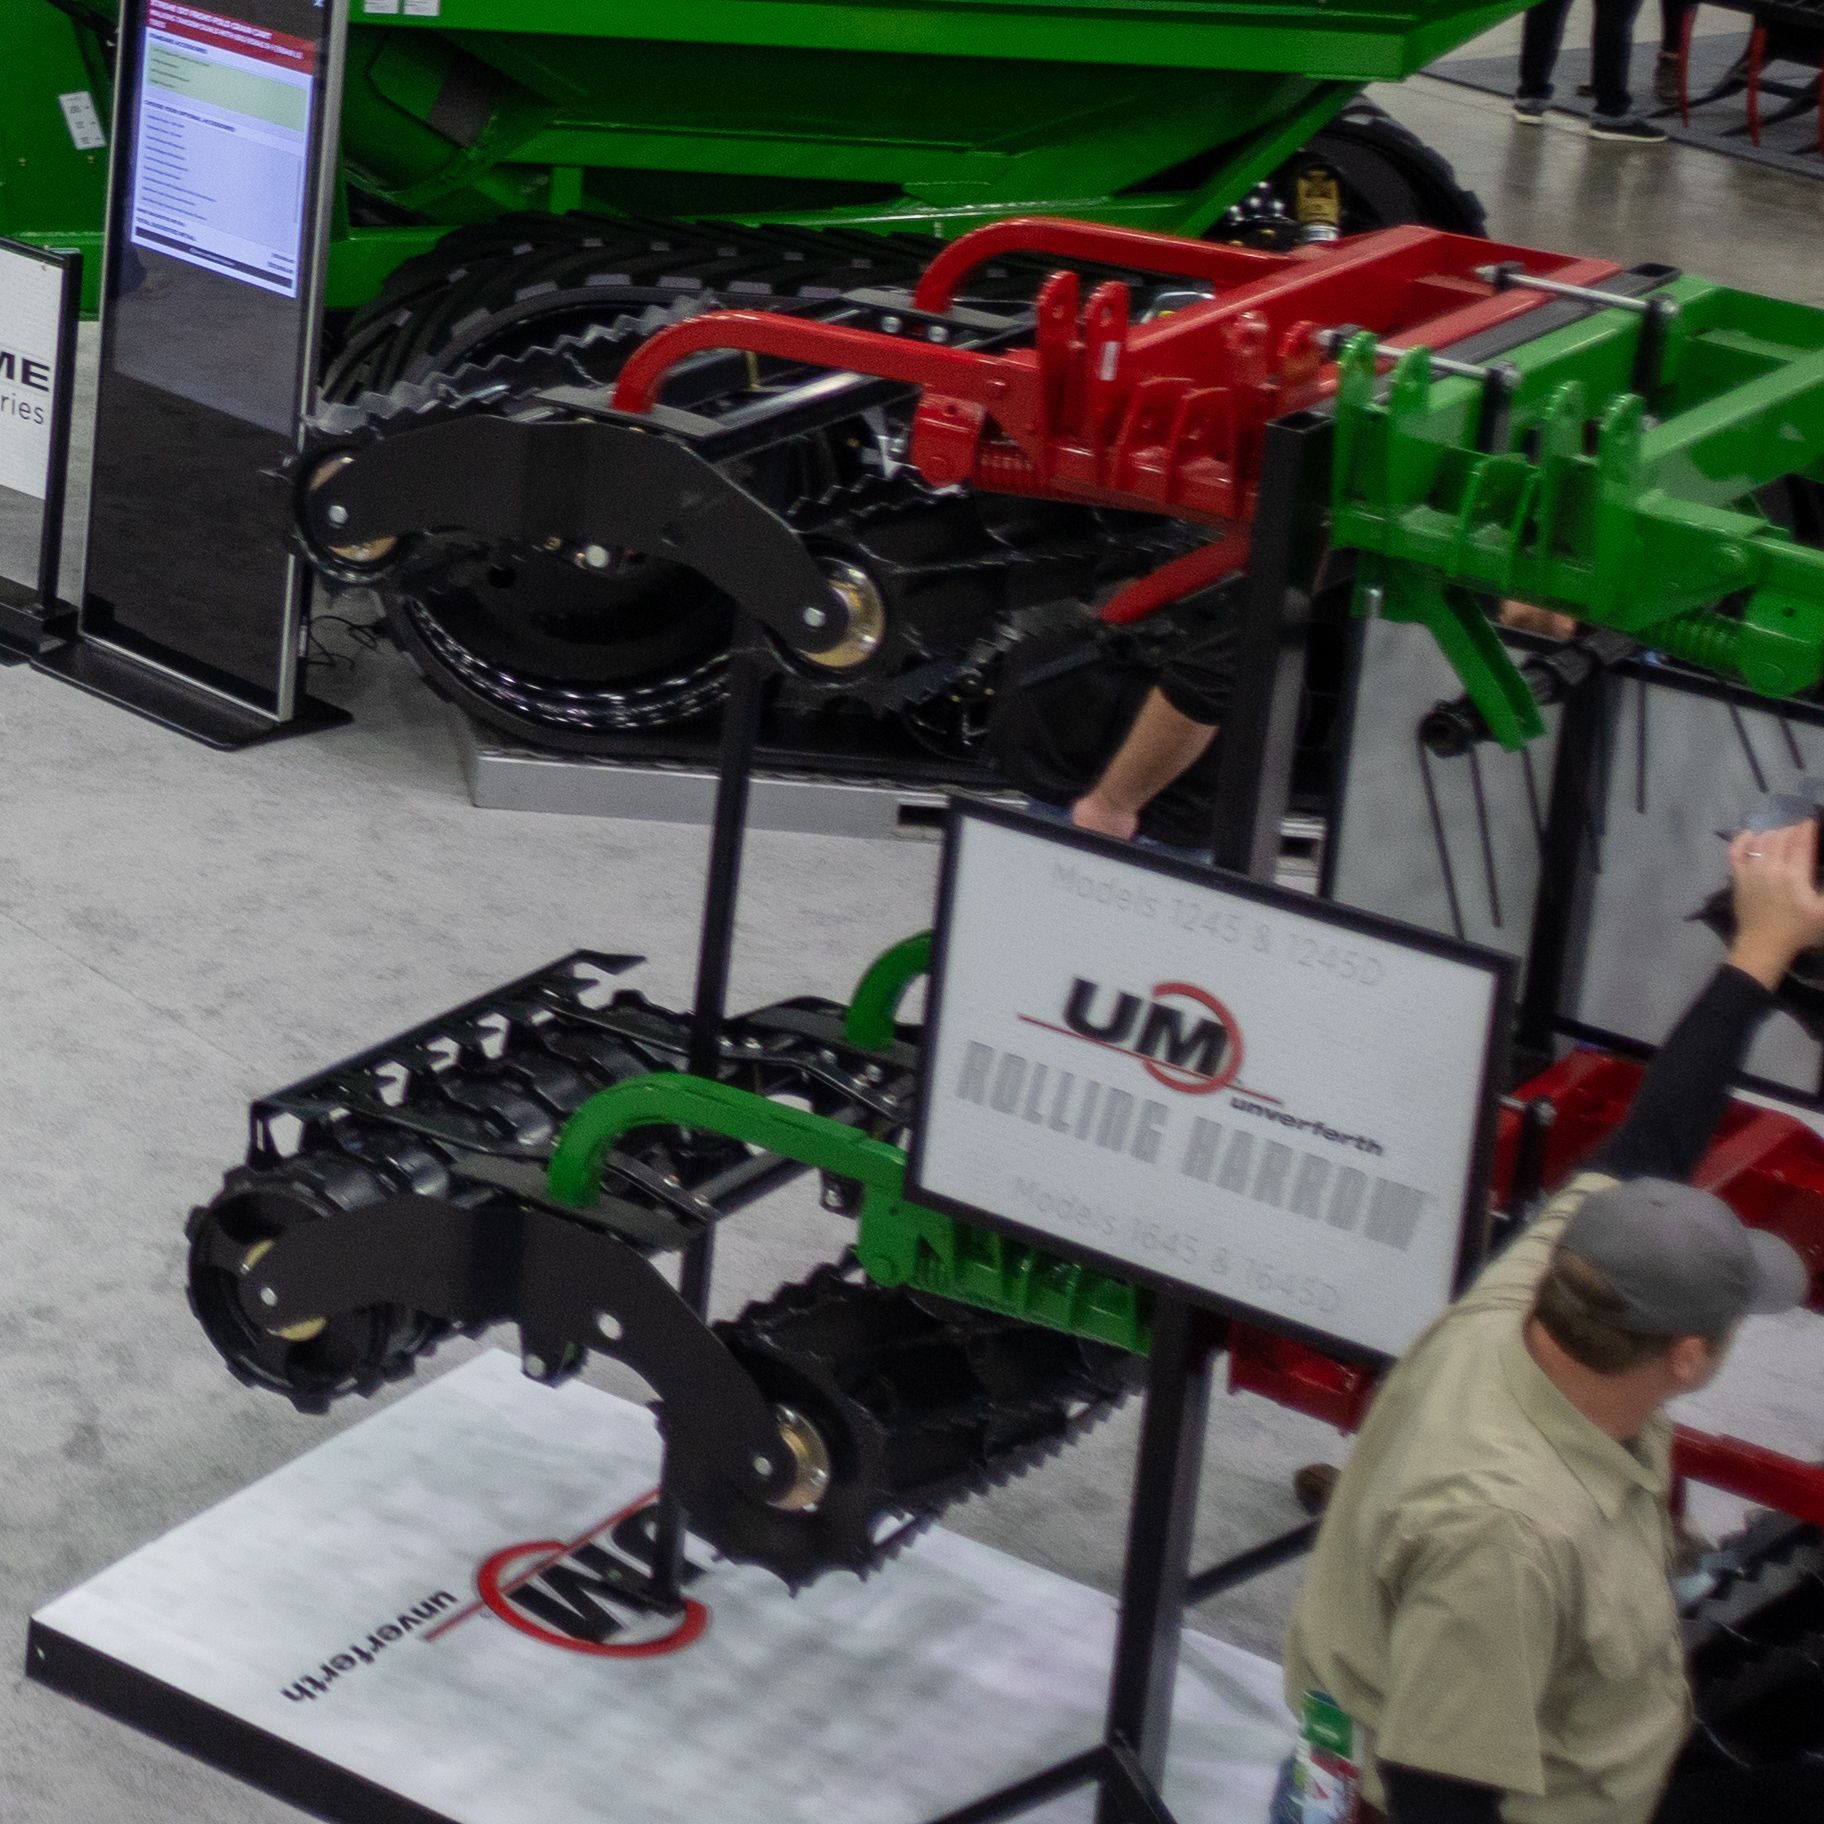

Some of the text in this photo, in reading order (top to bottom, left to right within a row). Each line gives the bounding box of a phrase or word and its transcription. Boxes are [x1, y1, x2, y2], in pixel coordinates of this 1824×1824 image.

[1050, 859, 1162, 924] Models
[1249, 913, 1277, 950] &
[1061, 977, 1230, 1080] UM
[957, 1038, 1436, 1251] ROLLING HARROW
[1228, 1095, 1385, 1159] unverferth
[281, 1587, 458, 1705] unverferth
